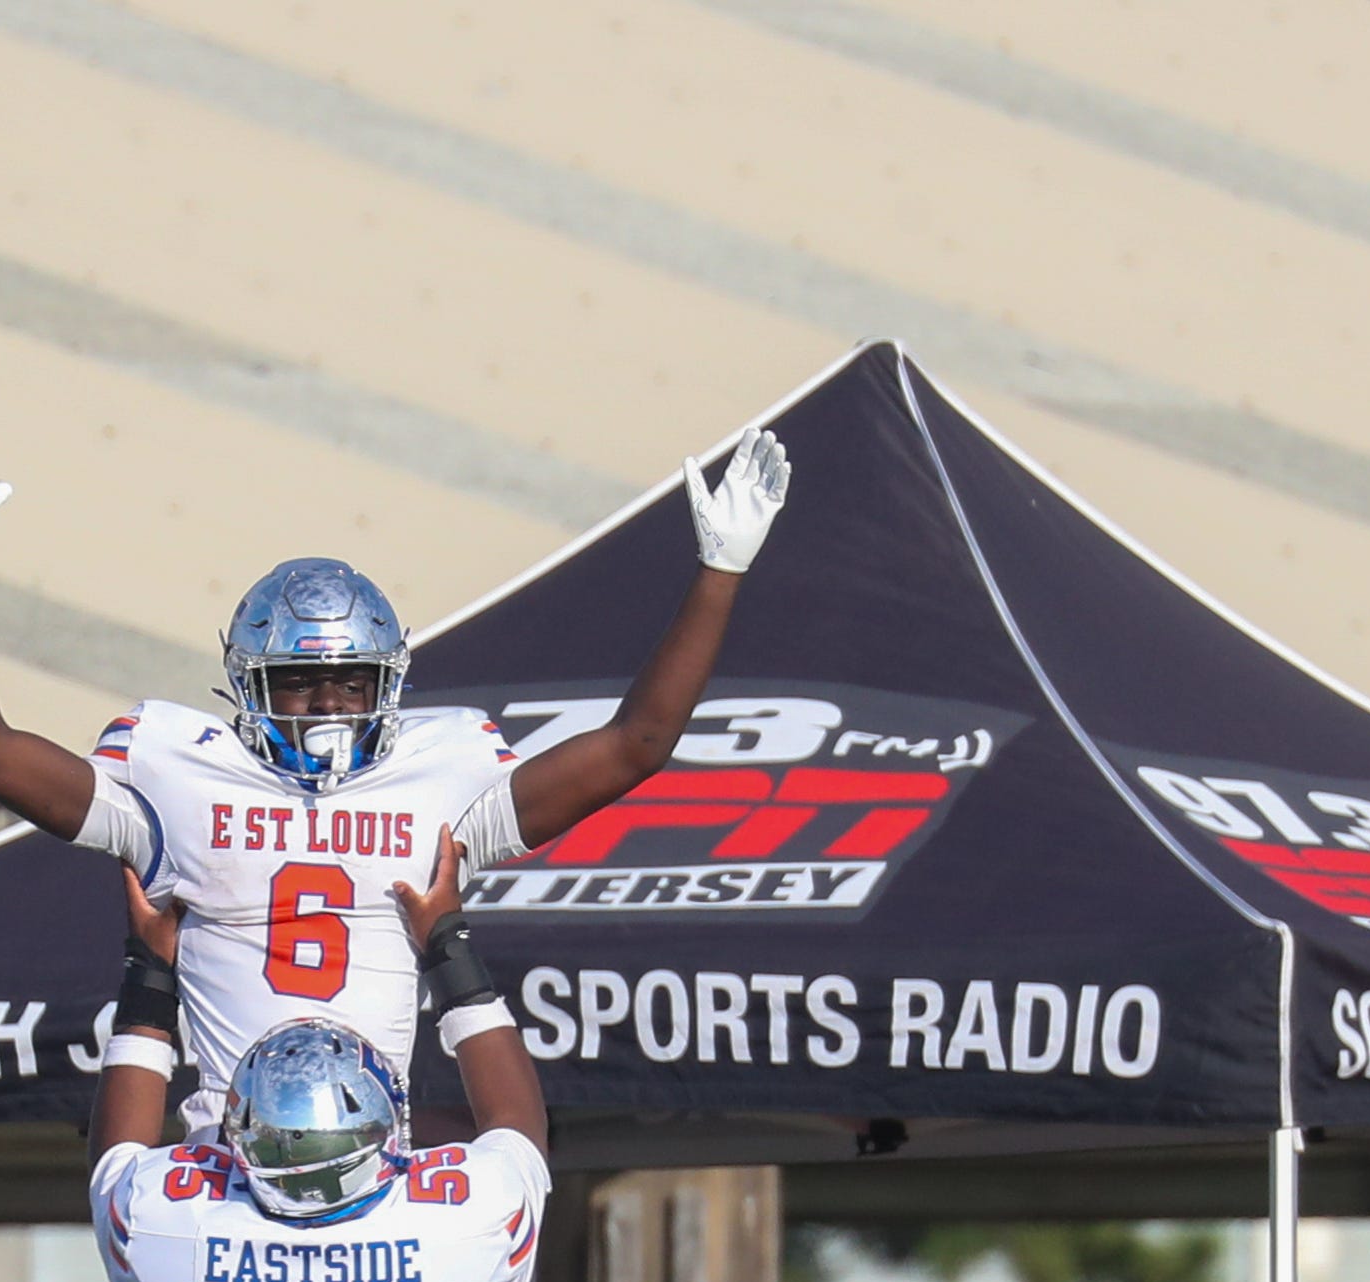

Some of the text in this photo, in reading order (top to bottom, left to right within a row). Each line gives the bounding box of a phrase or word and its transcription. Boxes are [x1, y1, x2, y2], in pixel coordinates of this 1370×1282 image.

[194, 726, 223, 745] F
[834, 730, 938, 759] FM
[210, 803, 414, 858] E ST LOUIS
[528, 866, 863, 906] JERSEY
[261, 860, 356, 1004] 6
[521, 965, 1163, 1080] SPORTS RADIO
